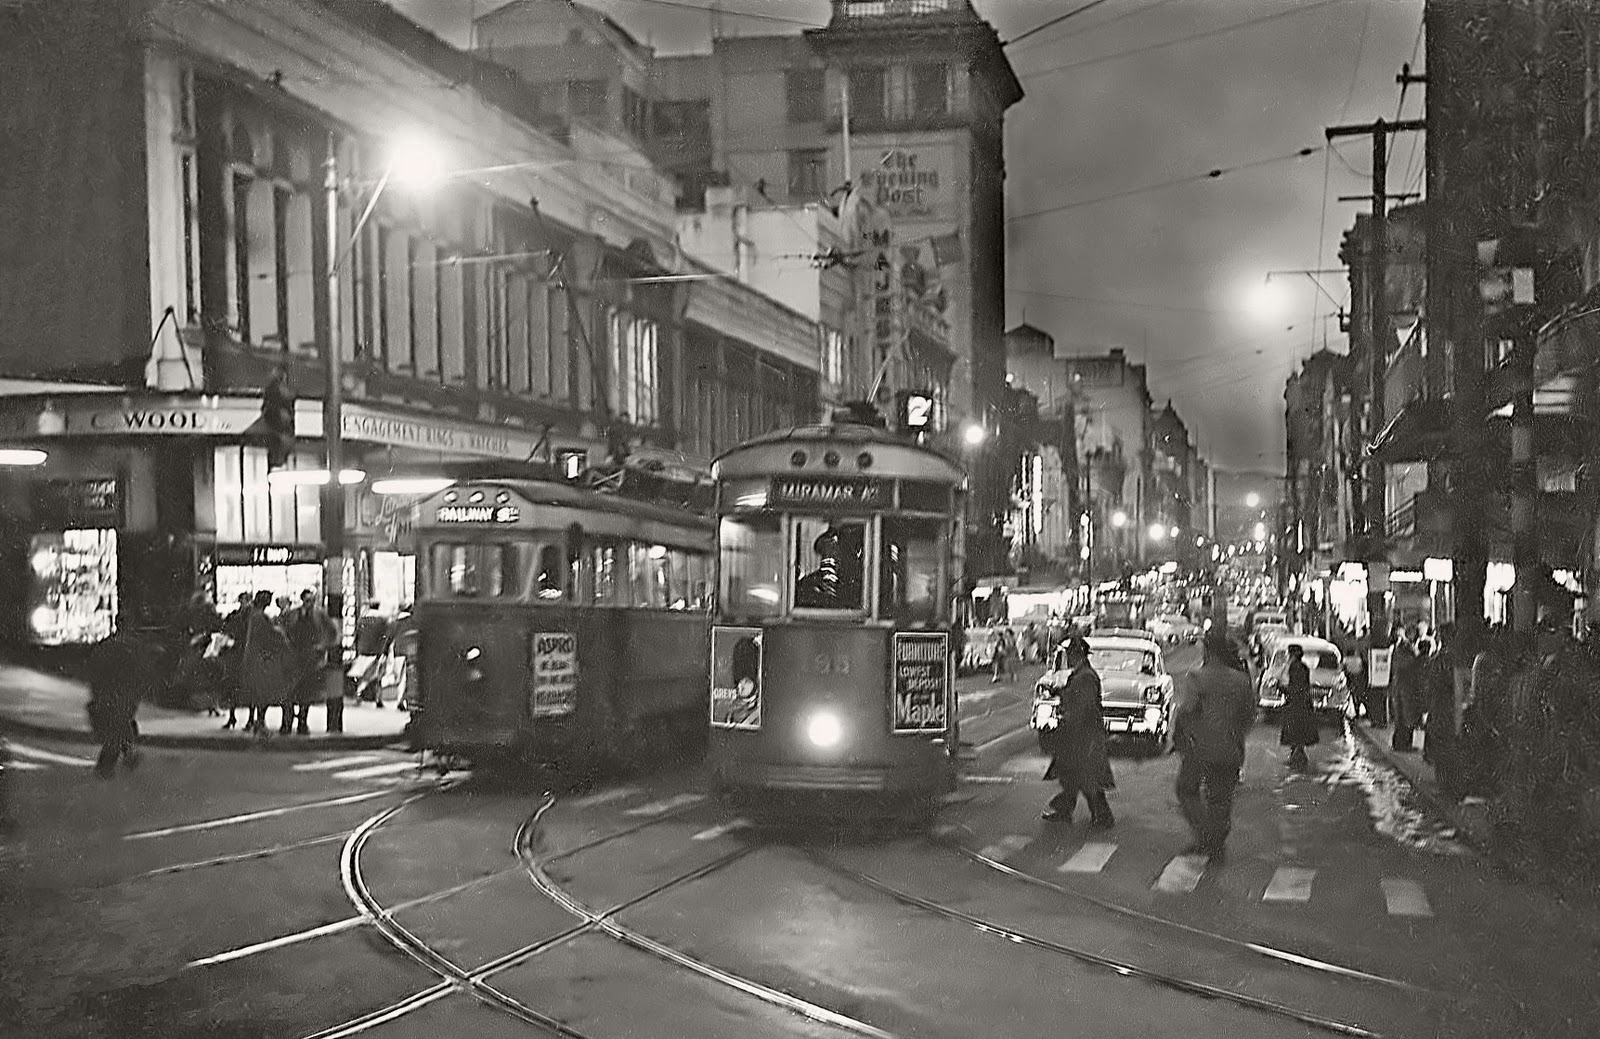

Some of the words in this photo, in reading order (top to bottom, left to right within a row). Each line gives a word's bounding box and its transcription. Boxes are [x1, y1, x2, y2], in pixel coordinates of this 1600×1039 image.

[906, 396, 932, 425] 2
[343, 415, 420, 442] ENGAGEMENT
[781, 483, 854, 500] MIRAMAR
[437, 506, 495, 522] RAILWAY
[897, 642, 946, 661] FURNITURE
[899, 665, 931, 678] LOWEST
[907, 677, 944, 690] DEPOSIT
[897, 692, 945, 727] Maple
